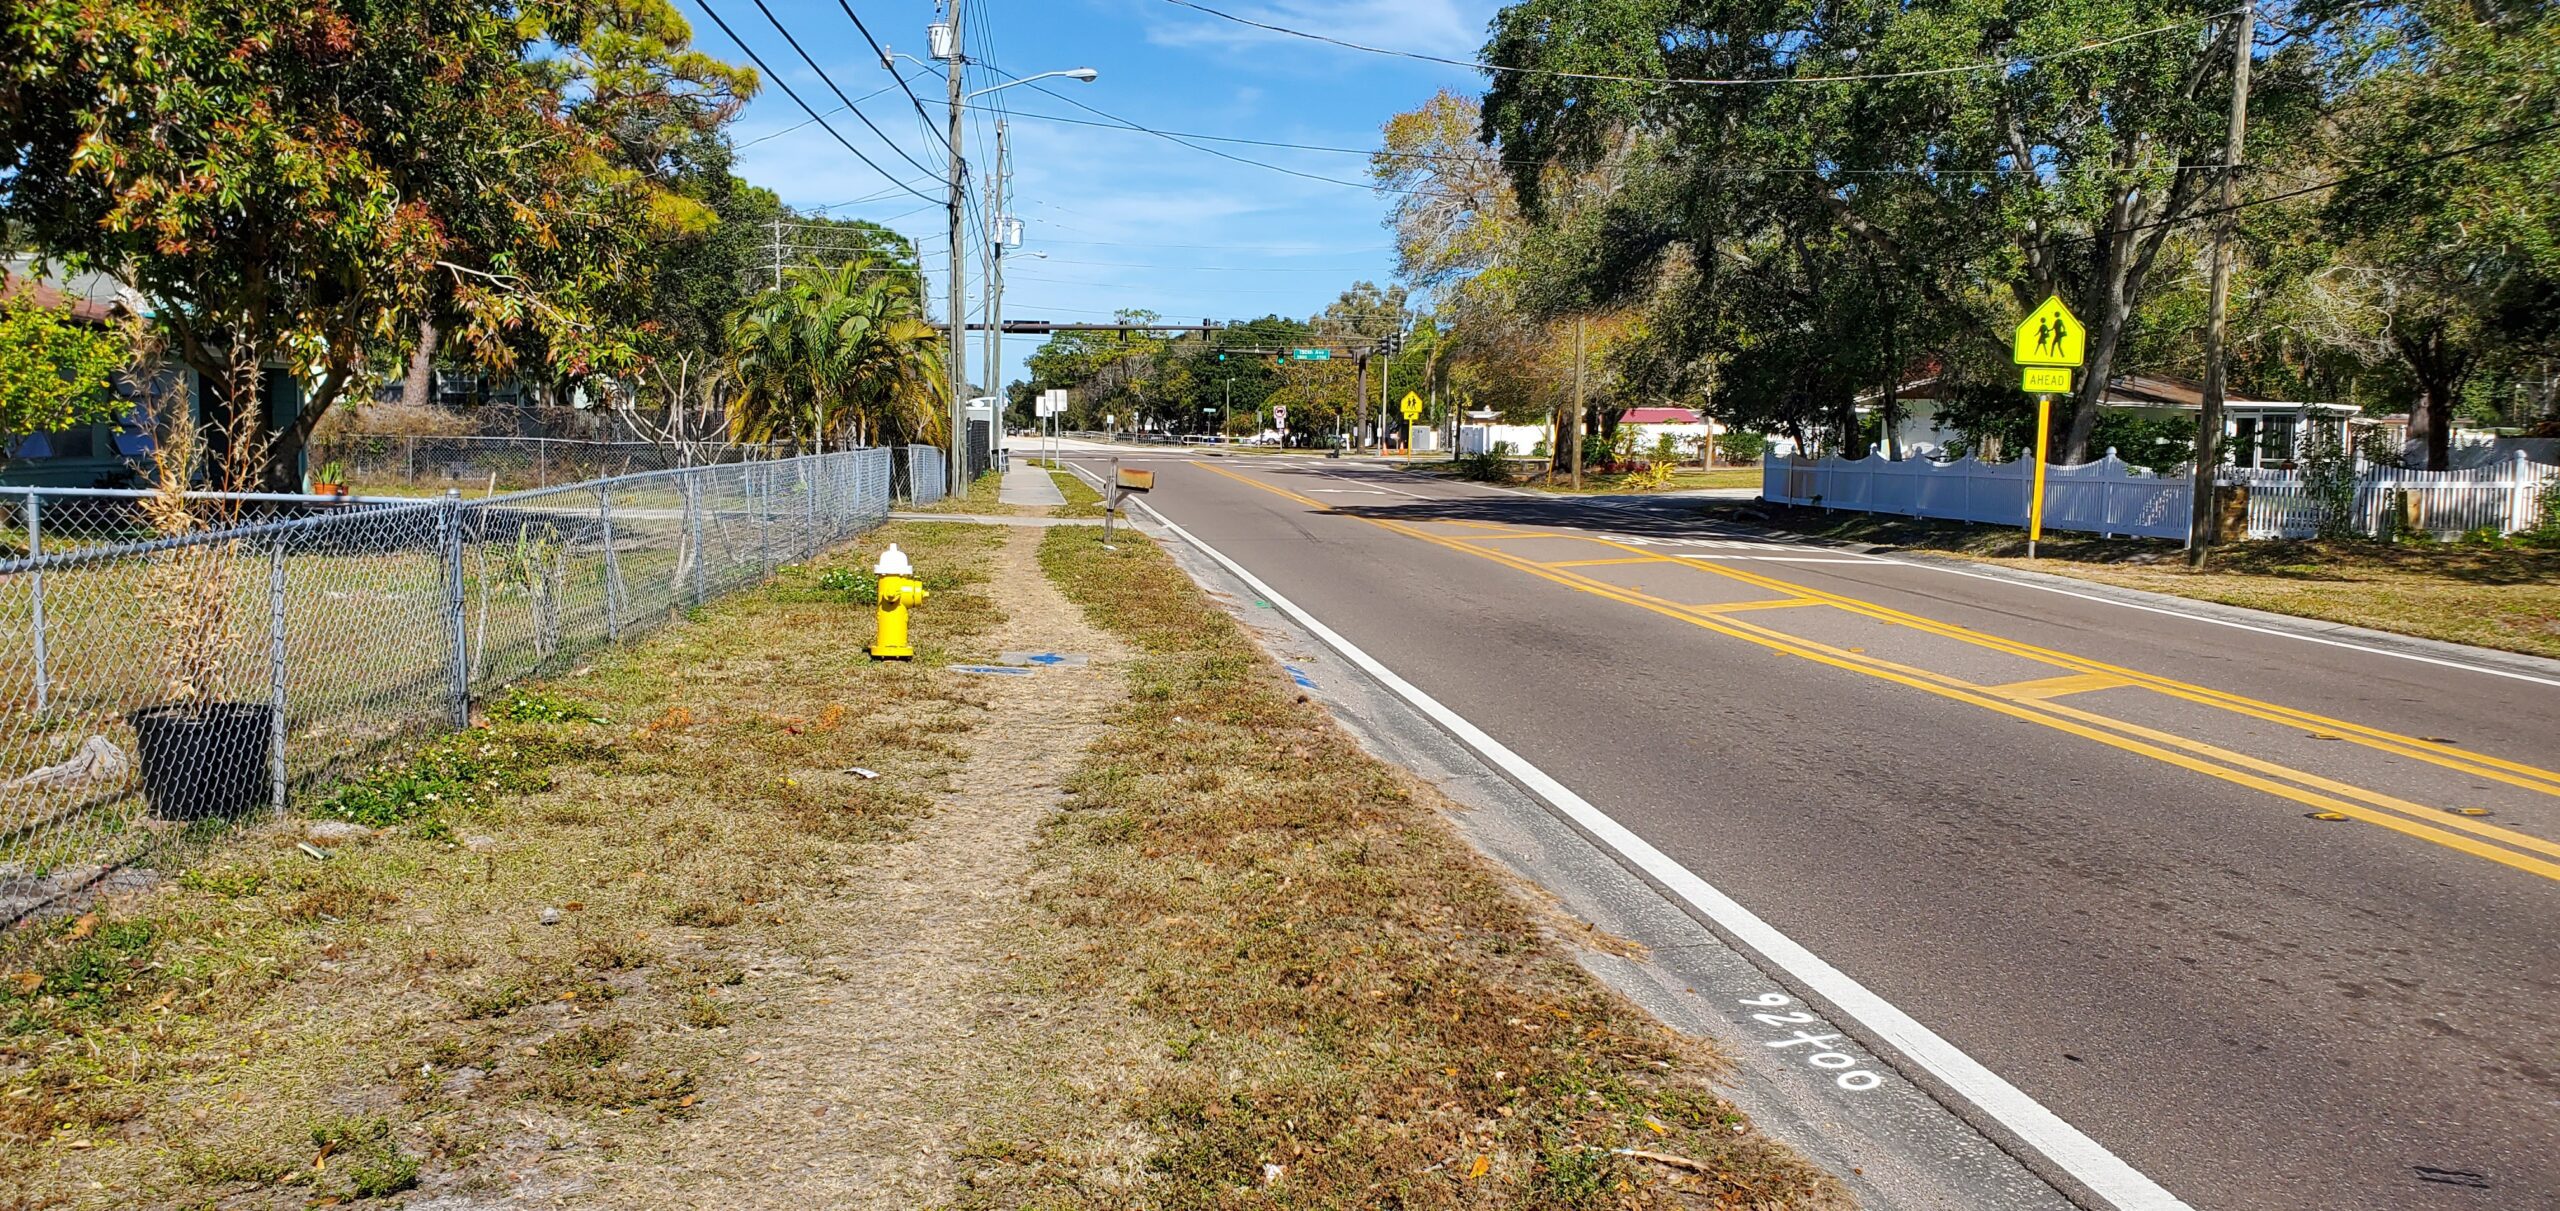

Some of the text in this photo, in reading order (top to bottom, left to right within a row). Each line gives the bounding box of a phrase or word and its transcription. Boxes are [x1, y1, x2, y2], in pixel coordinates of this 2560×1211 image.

[2030, 373, 2065, 386] AHEAD
[1598, 535, 1826, 552] SCHOOL
[1738, 993, 1882, 1091] 92+00
